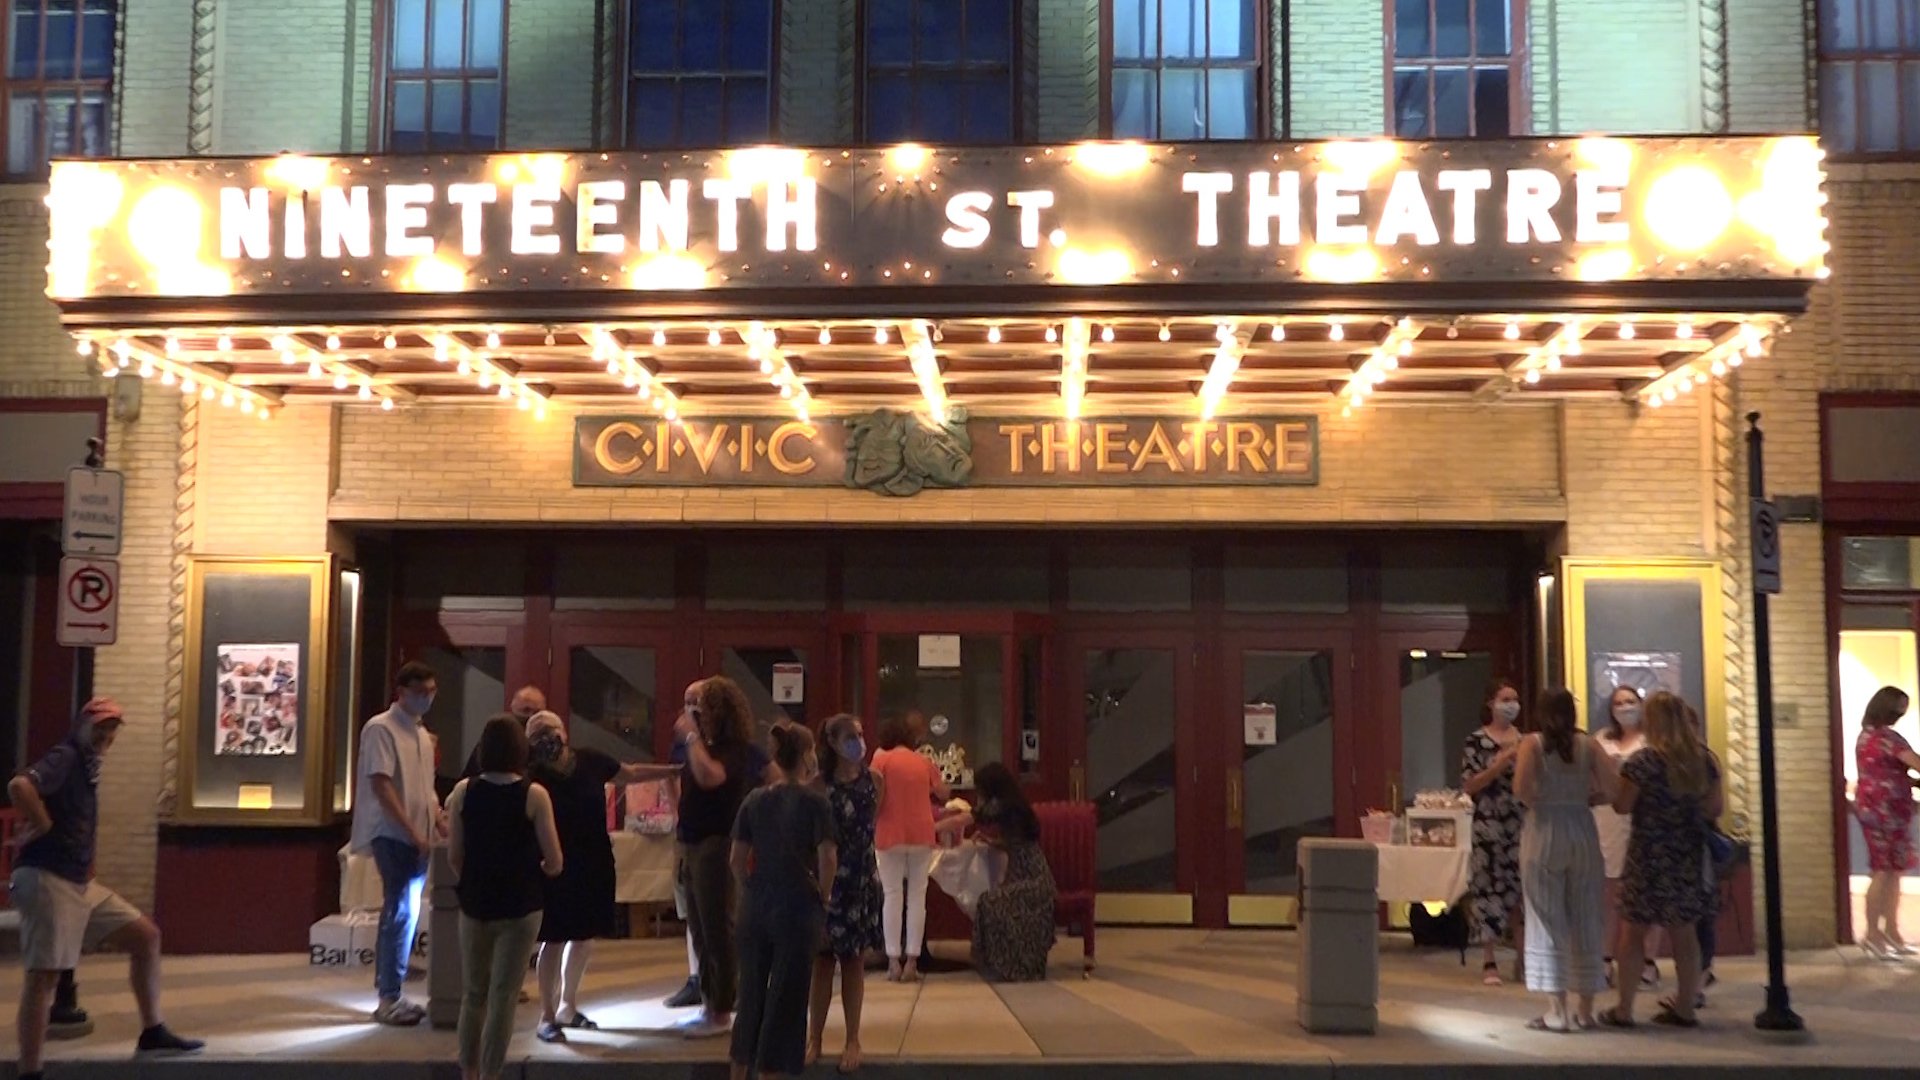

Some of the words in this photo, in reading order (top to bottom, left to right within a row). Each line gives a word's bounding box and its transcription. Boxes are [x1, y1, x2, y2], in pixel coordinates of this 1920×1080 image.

[218, 179, 818, 260] NINETEENTH
[940, 189, 1068, 249] ST.
[1182, 168, 1632, 248] THEATRE
[71, 511, 117, 525] PARKING
